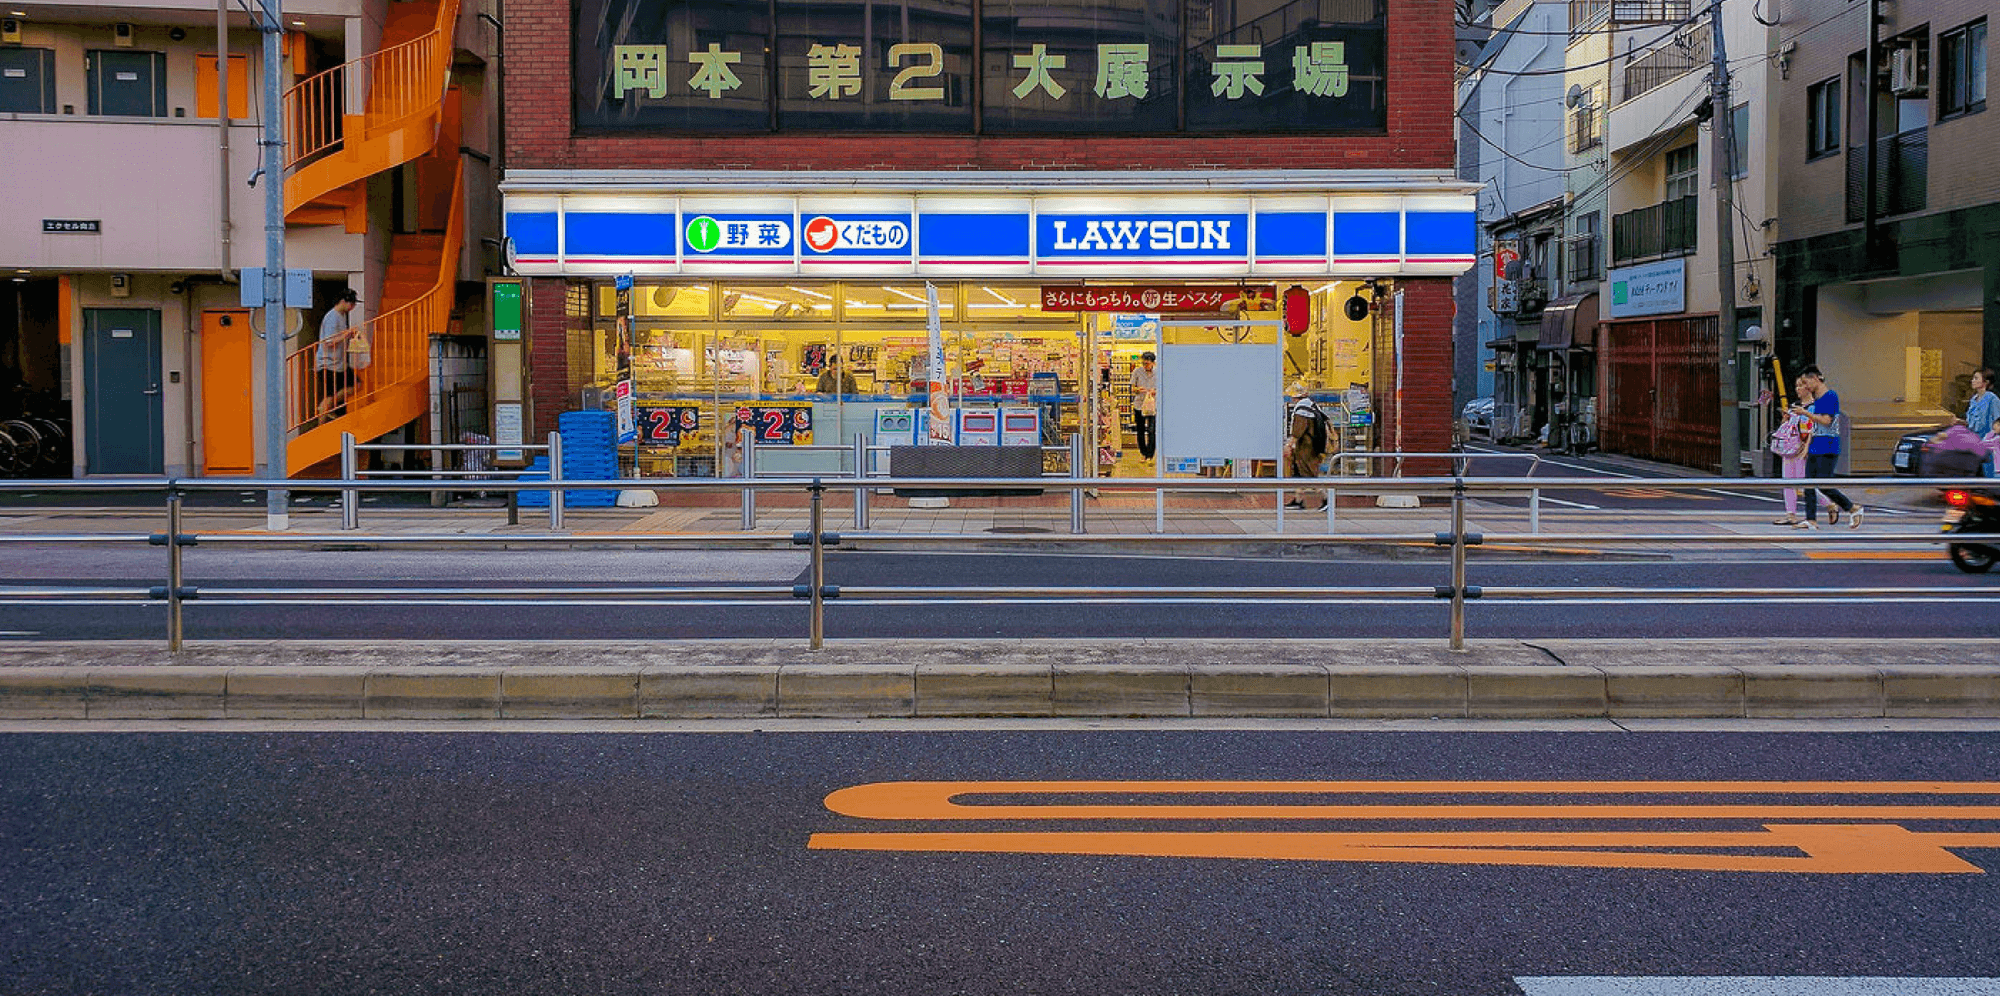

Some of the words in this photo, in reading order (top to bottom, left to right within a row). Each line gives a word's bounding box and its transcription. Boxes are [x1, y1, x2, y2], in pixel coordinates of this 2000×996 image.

[727, 223, 780, 246] 野菜
[841, 224, 904, 246] くだもの
[1053, 220, 1231, 250] LAWSON
[650, 409, 671, 439] 2
[763, 410, 784, 440] 2
